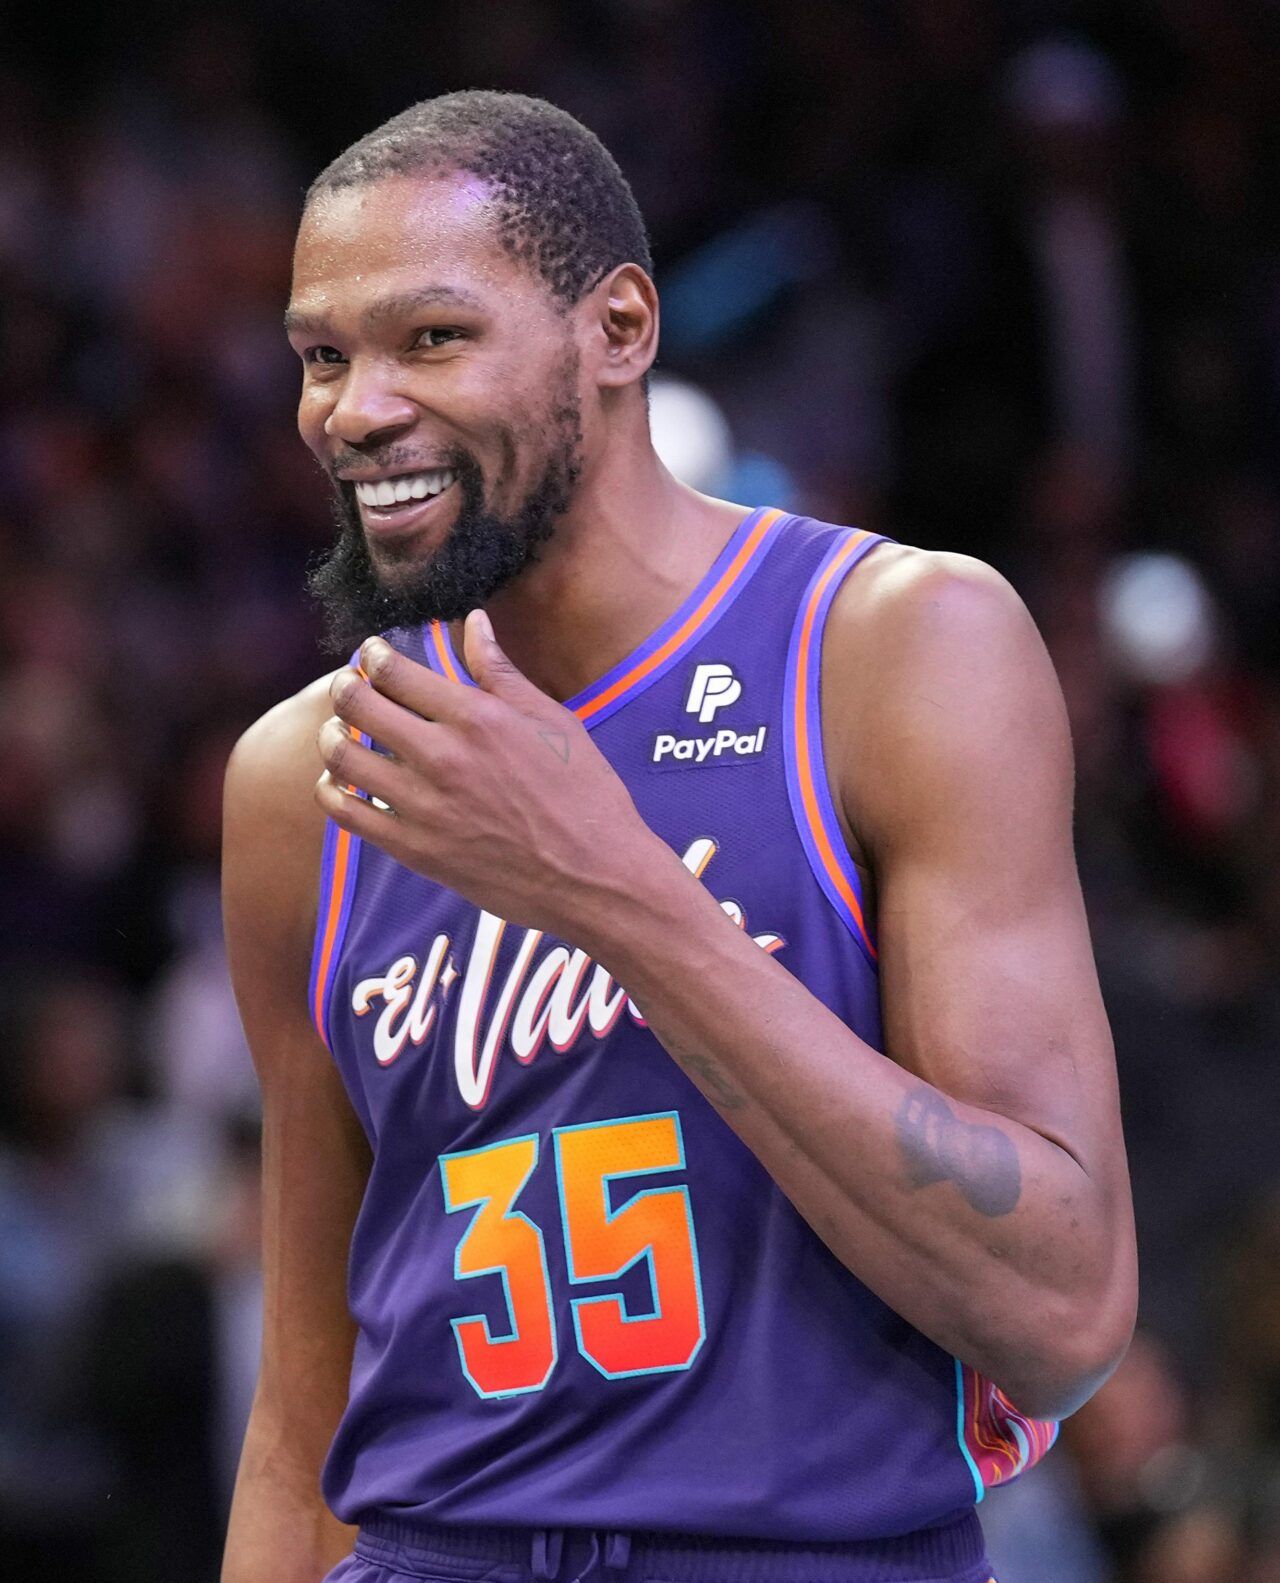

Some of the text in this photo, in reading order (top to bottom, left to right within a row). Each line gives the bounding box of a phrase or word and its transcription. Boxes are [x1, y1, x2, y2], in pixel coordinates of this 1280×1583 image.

[652, 726, 767, 763] PayPal
[351, 932, 450, 1067] El
[437, 1110, 707, 1400] 35
